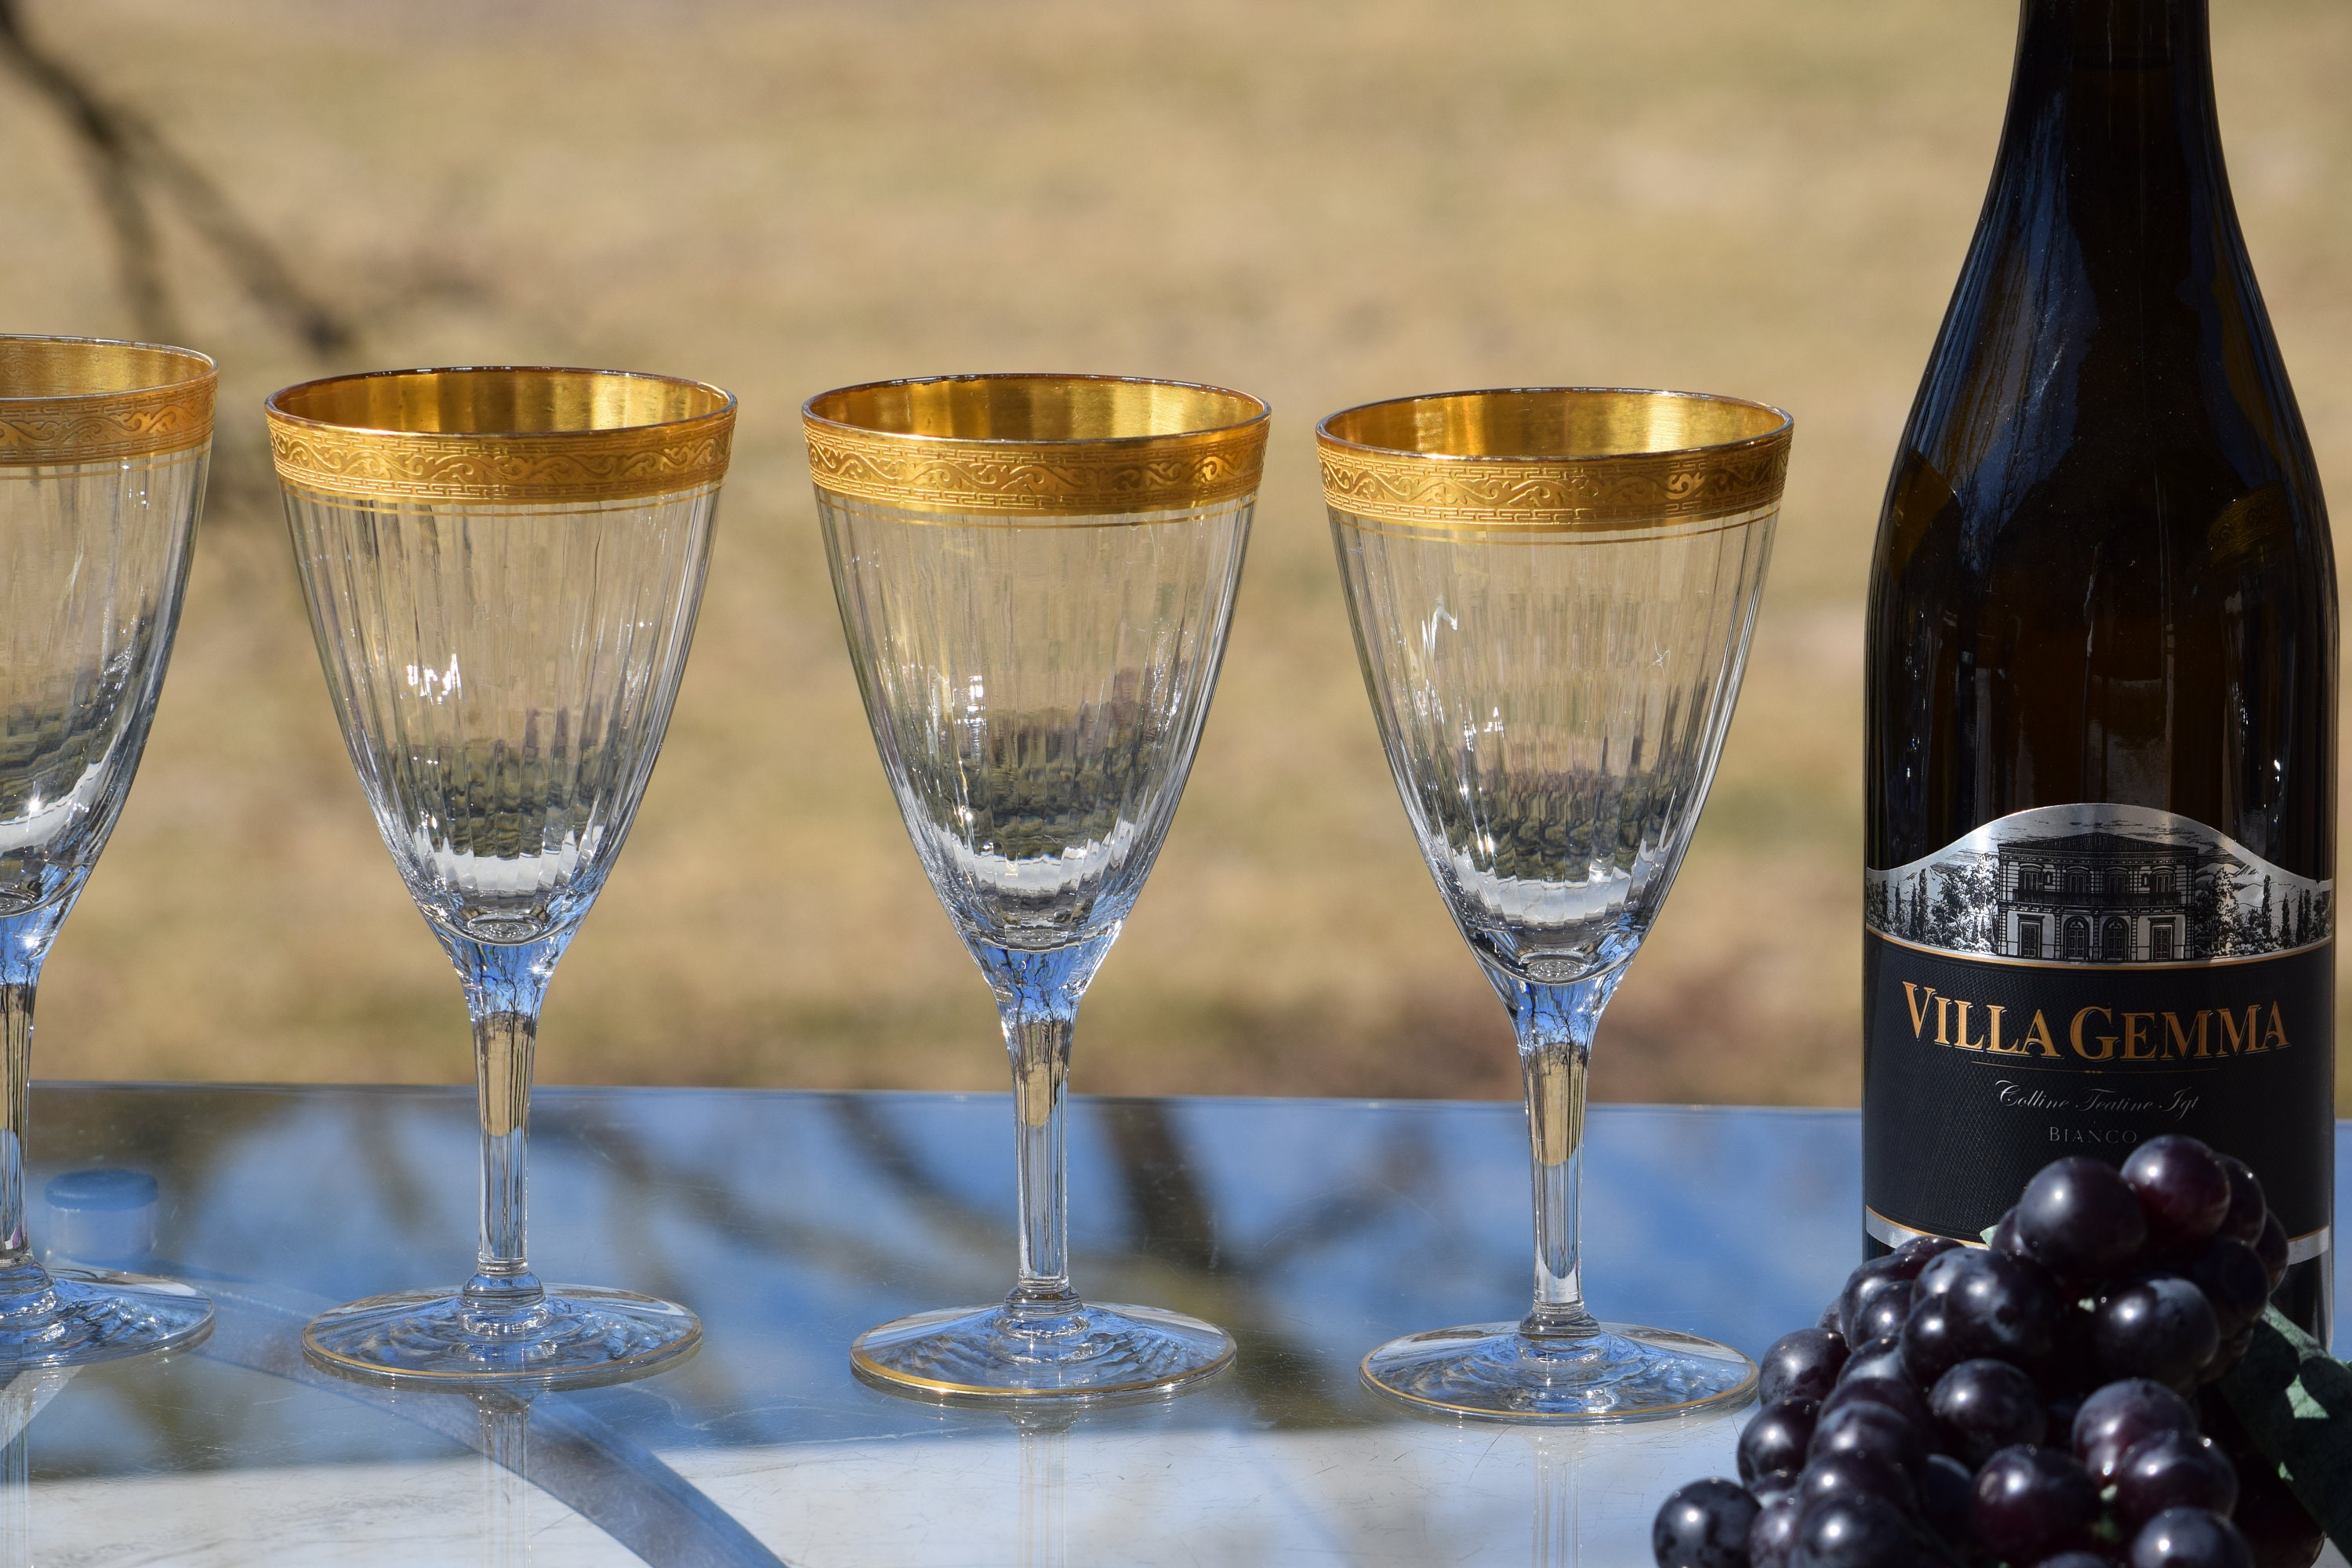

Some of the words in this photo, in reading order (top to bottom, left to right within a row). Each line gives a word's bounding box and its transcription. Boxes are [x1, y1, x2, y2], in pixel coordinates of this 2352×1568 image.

[1902, 981, 2063, 1059] VILLA
[2069, 1000, 2291, 1062] GEMMA
[1995, 1080, 2070, 1110] Colline
[2076, 1087, 2154, 1112] Teatine
[2049, 1126, 2137, 1144] BIANCO
